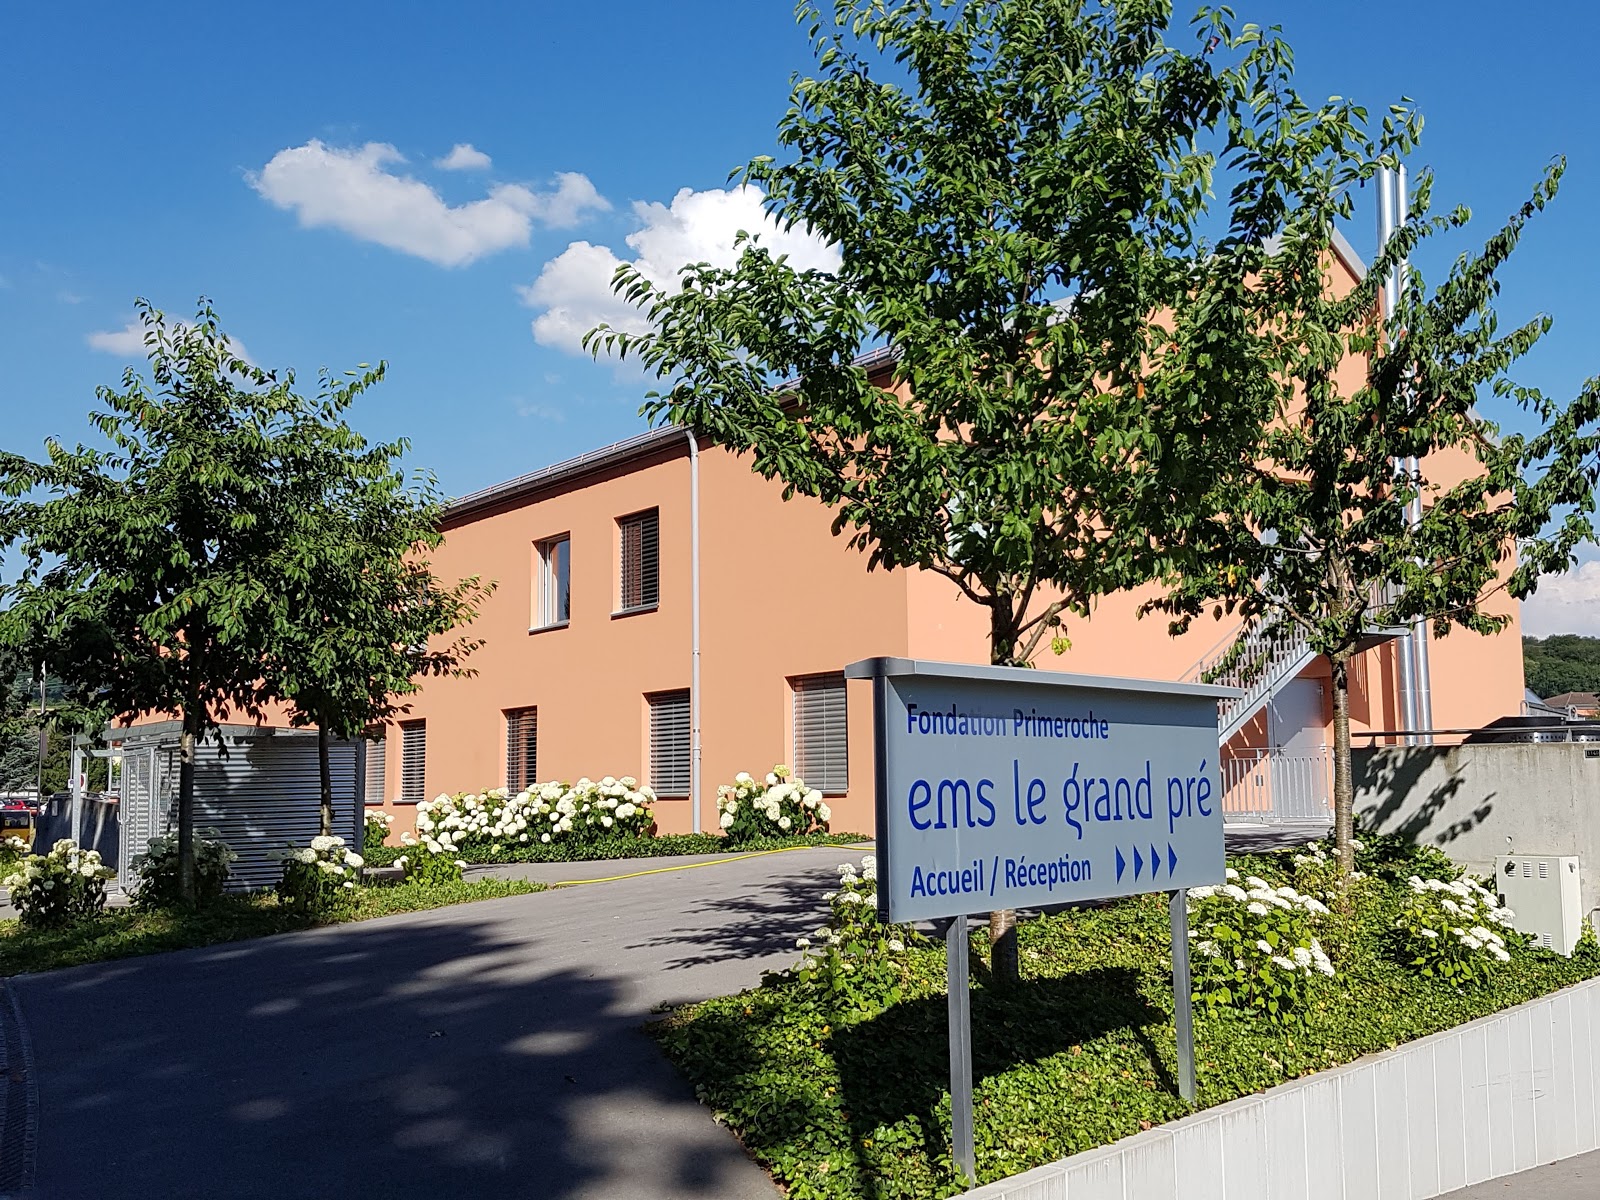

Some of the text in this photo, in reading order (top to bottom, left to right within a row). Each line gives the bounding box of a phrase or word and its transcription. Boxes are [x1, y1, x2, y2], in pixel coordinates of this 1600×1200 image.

[906, 703, 1109, 740] Fondation Primeroche
[909, 758, 1212, 840] ems le grand pré
[910, 859, 984, 898] Accueil
[1005, 854, 1091, 892] Réception
